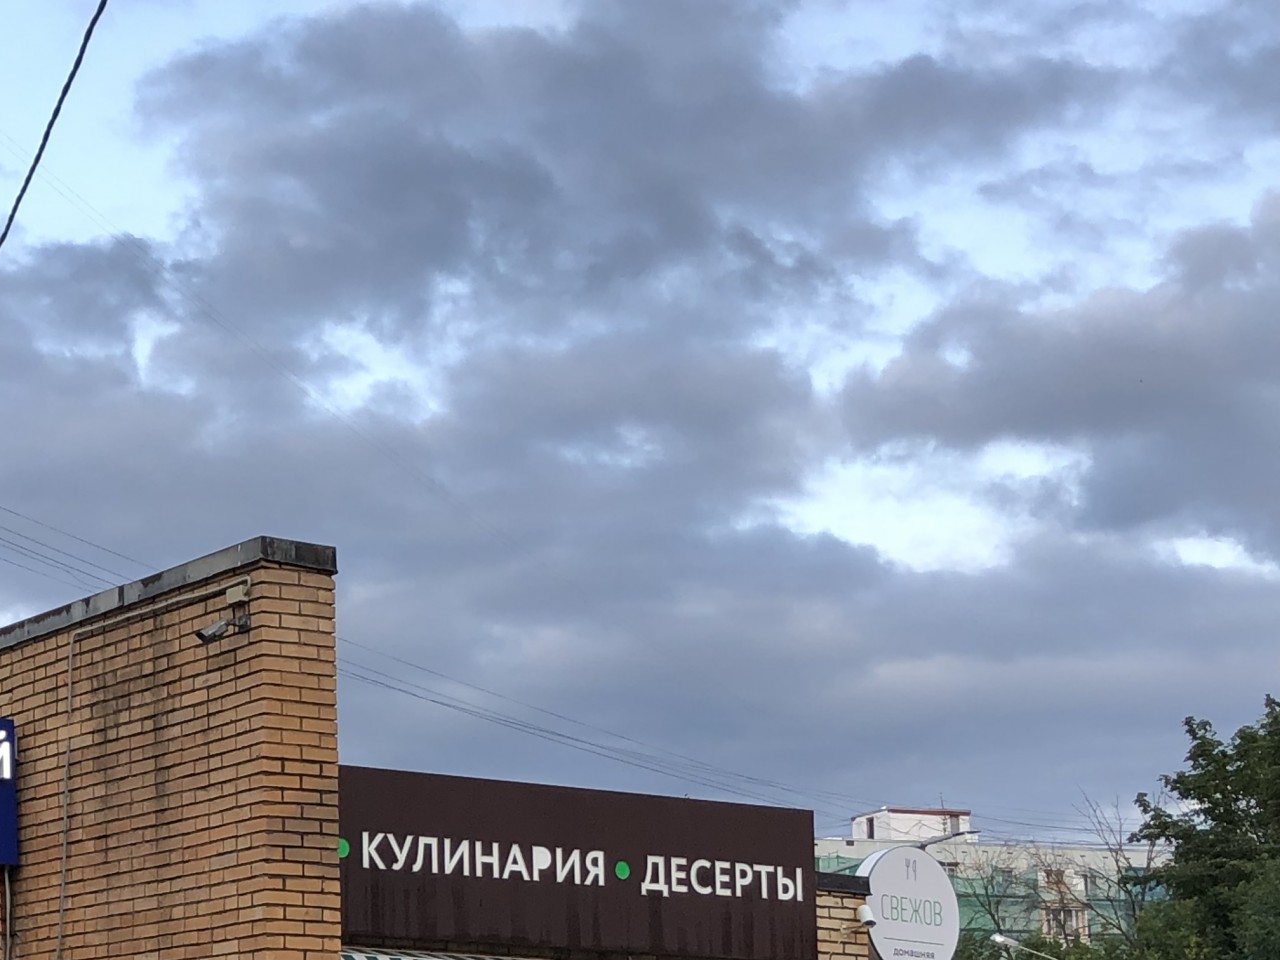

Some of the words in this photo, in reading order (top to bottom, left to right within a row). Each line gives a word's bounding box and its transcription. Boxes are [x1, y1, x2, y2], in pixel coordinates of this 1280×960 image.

[360, 830, 606, 888] КУЛИНАРИЯ
[640, 854, 805, 903] ДЕСЕРТЫ
[881, 894, 943, 927] СВЕЖОВ
[893, 948, 935, 959] домашняя
